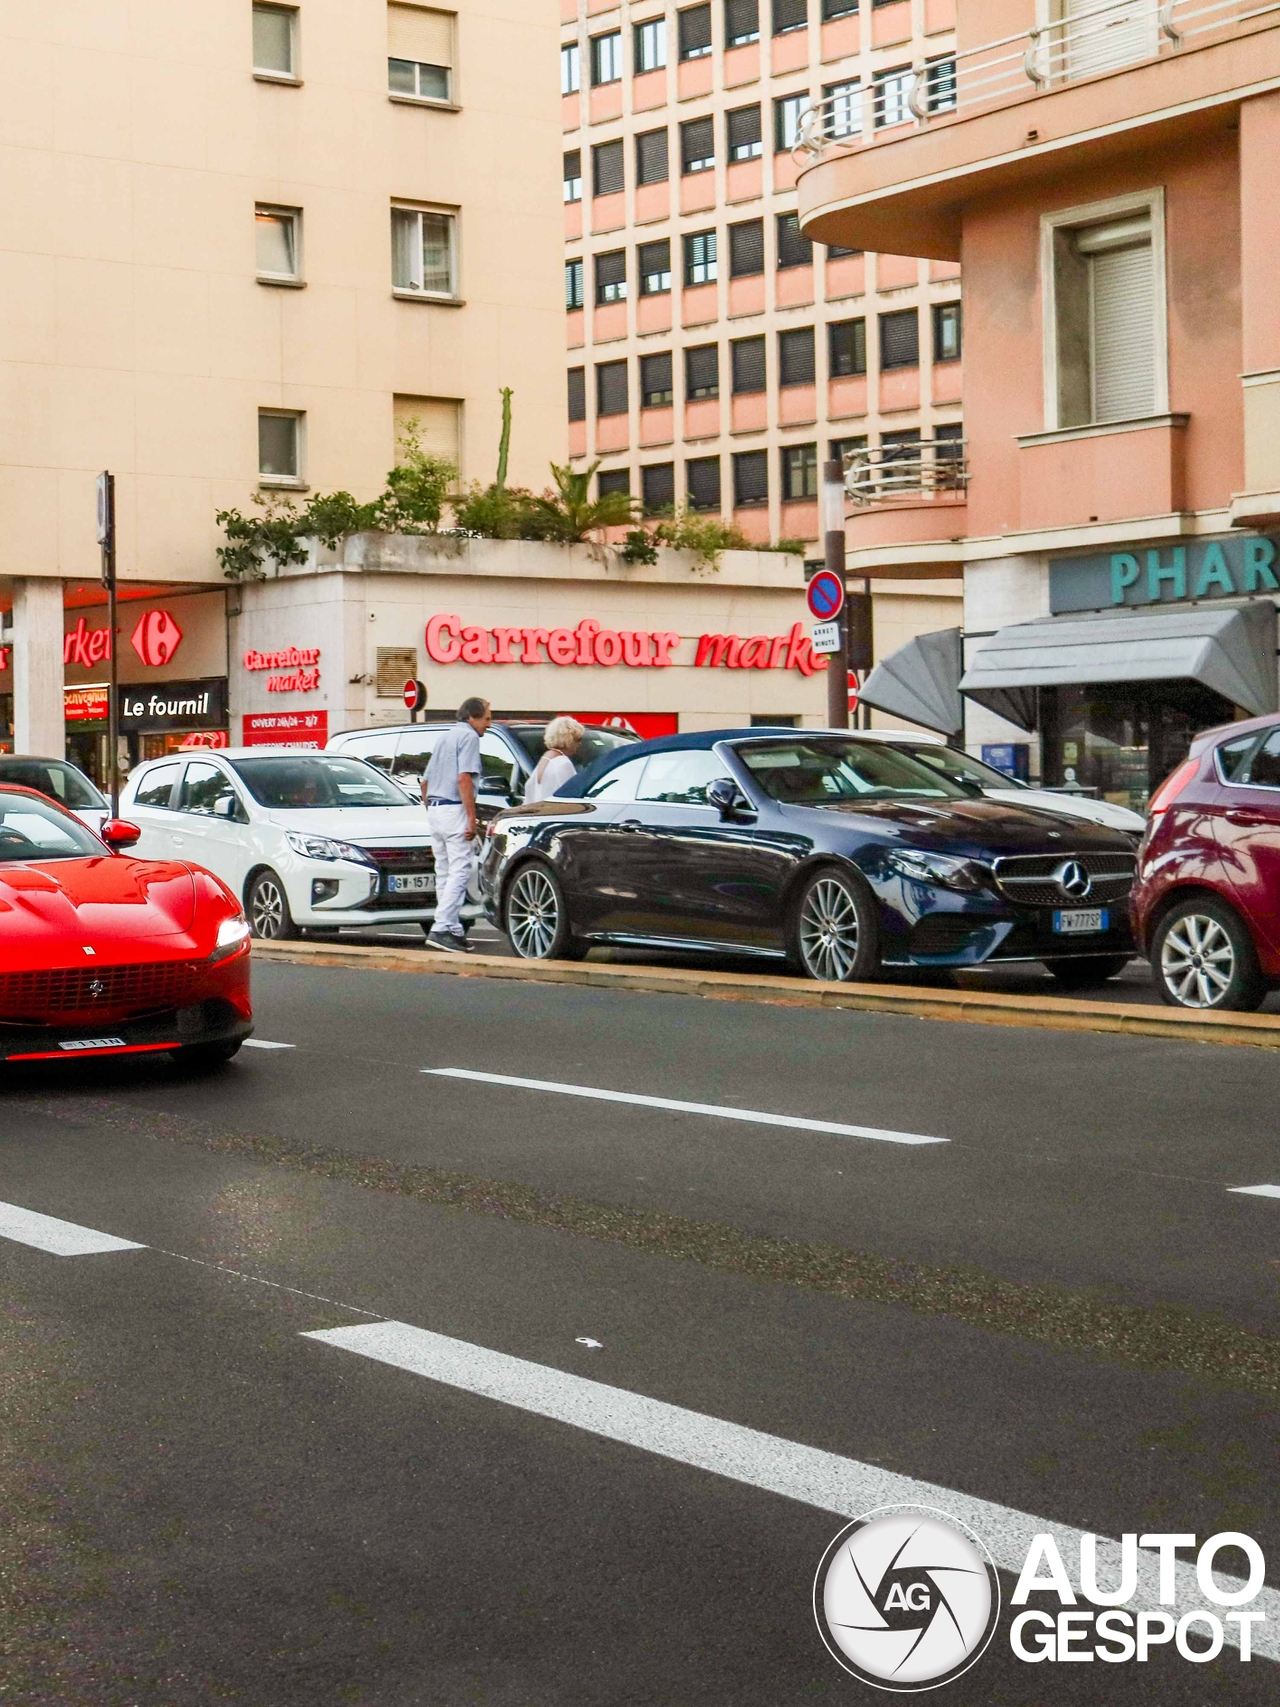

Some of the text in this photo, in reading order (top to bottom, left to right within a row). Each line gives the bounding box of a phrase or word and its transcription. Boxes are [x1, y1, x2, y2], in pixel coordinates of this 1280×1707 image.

[1110, 537, 1280, 604] PHAR
[426, 614, 831, 677] Carrefour marke
[244, 646, 320, 671] Carrefour
[266, 668, 320, 693] market
[123, 698, 146, 717] Le
[148, 692, 209, 717] fournil
[251, 717, 277, 728] OUVERT
